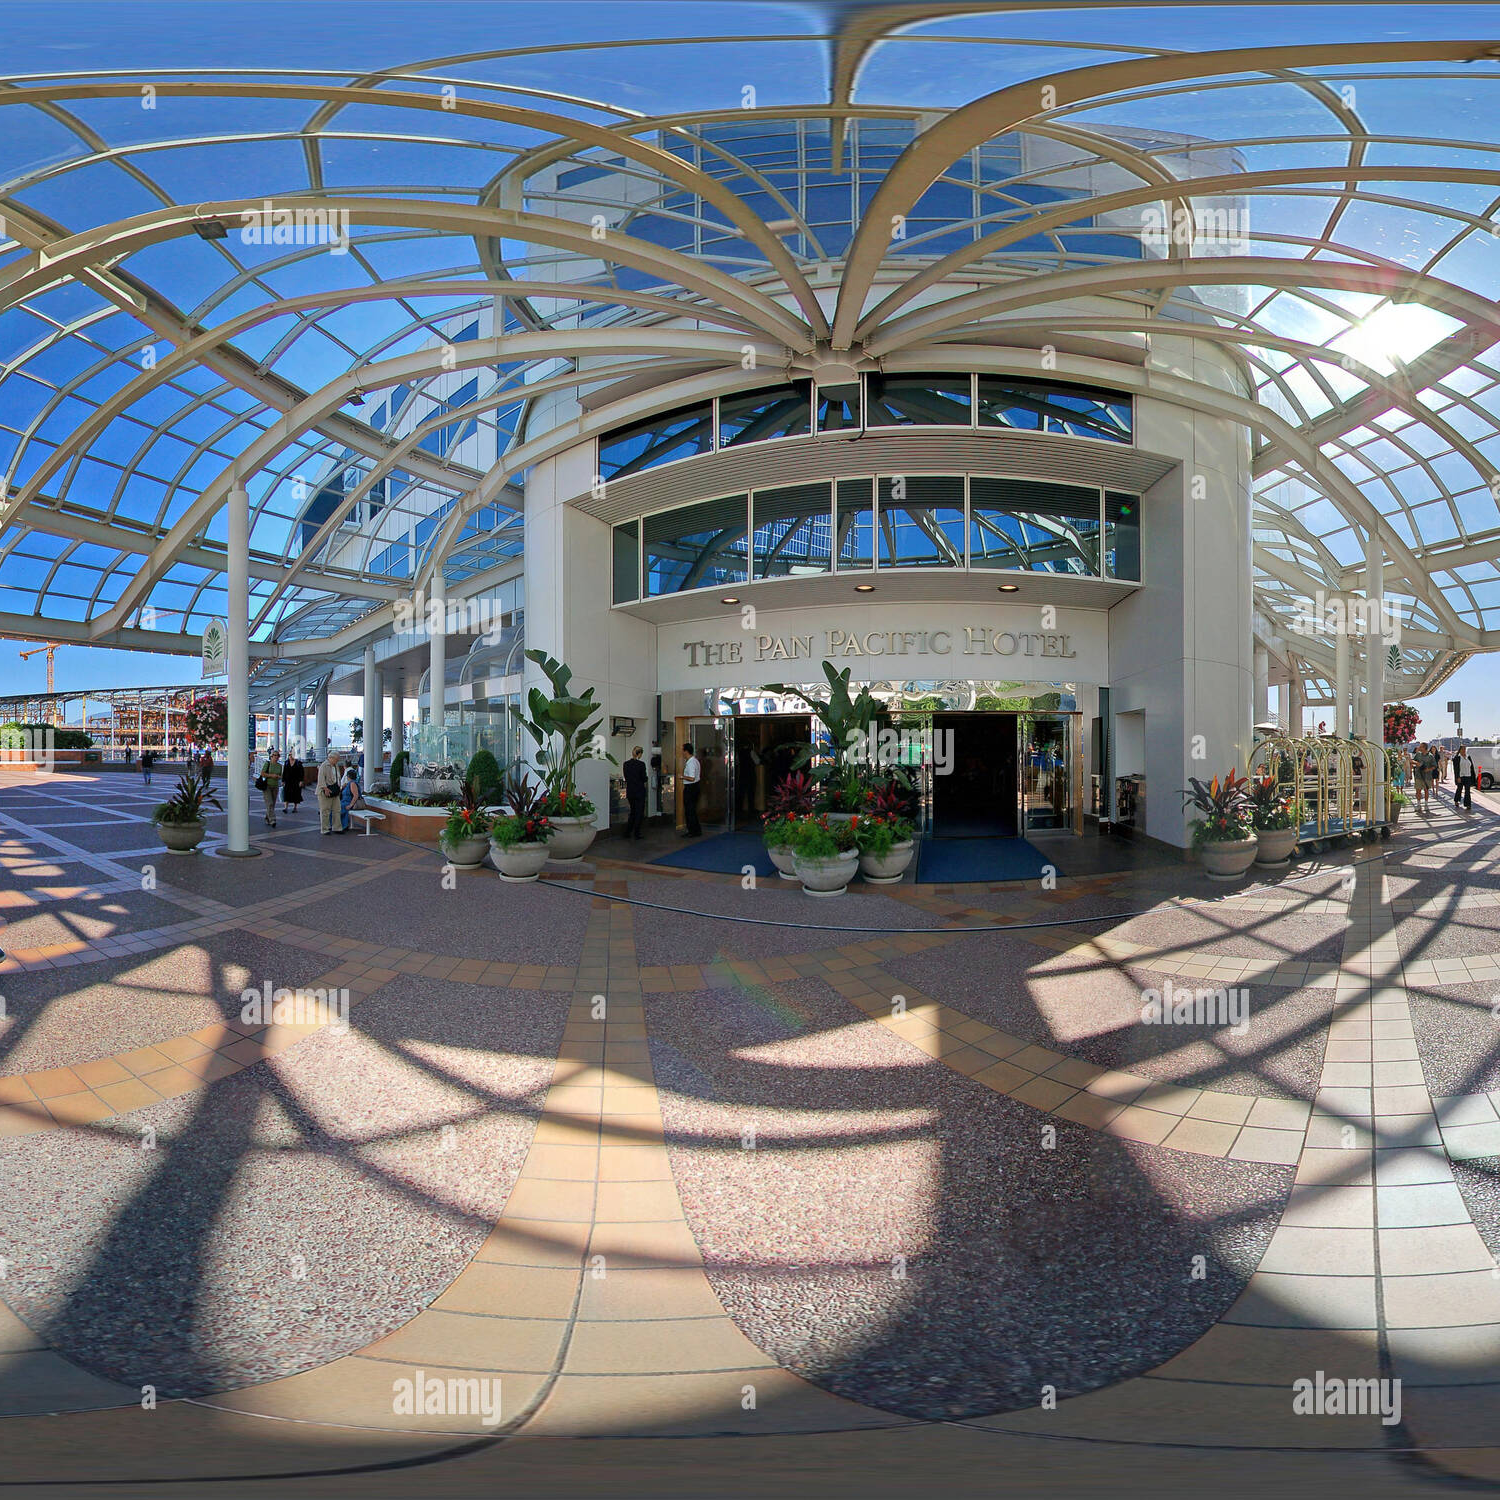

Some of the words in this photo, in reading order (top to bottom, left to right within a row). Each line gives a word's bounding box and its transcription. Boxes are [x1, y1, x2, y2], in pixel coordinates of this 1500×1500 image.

[683, 640, 743, 667] THE
[754, 634, 813, 661] PAN
[825, 629, 952, 658] PACIFIC
[963, 626, 1077, 658] HOTEL
